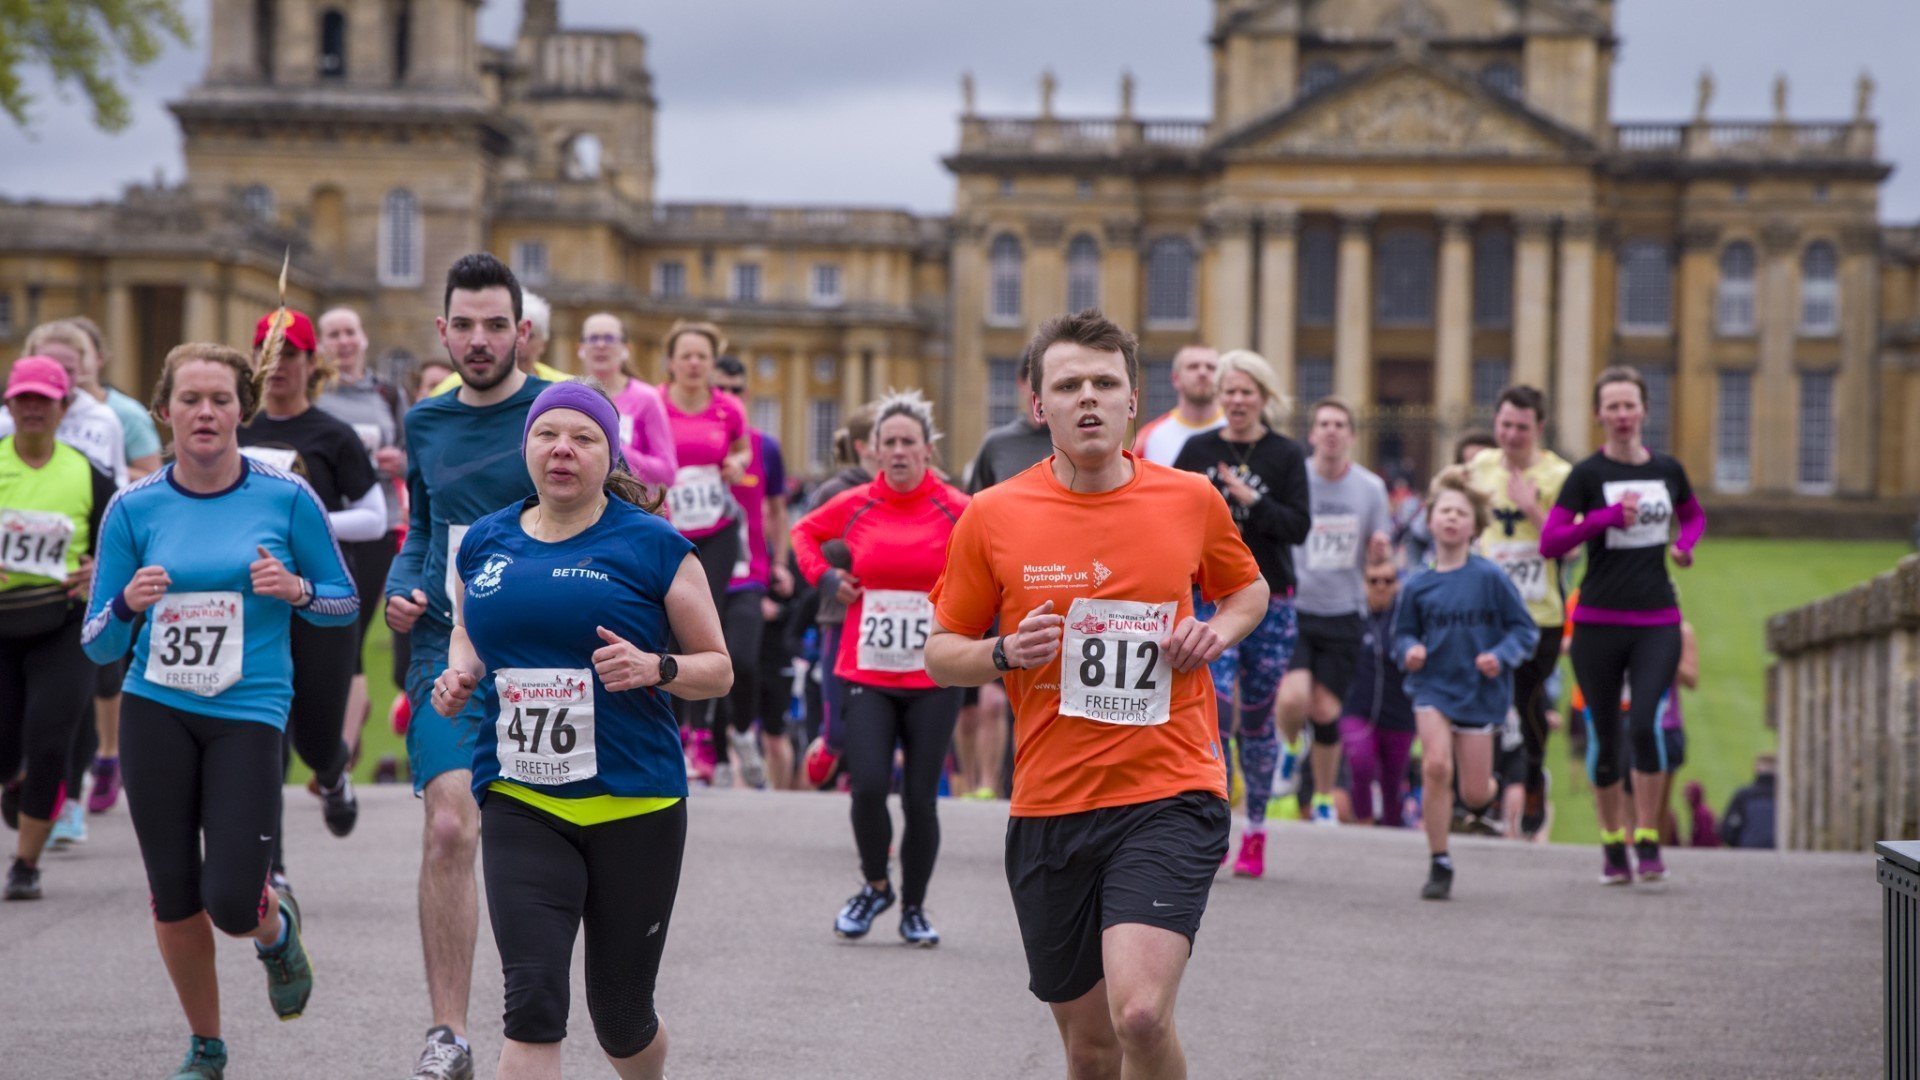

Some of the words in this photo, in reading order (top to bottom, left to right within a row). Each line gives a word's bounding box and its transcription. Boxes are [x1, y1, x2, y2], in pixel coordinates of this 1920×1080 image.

[672, 484, 722, 511] 1916
[2, 532, 65, 565] 1514
[552, 568, 609, 582] BETTINA
[1023, 563, 1066, 573] Muscular
[1023, 572, 1073, 583] Dystrophy
[1074, 571, 1088, 580] UK
[181, 609, 200, 619] FUN
[202, 608, 224, 617] RUN
[864, 616, 929, 650] 2315
[1108, 619, 1133, 631] FUN
[1134, 620, 1158, 632] RUN
[160, 626, 228, 667] 357
[1080, 637, 1159, 690] 812
[166, 672, 220, 685] FREETHS
[523, 687, 544, 699] FUN
[546, 687, 572, 698] RUN
[1085, 694, 1149, 711] FREETHS
[1085, 709, 1147, 722] SOLICITORS
[507, 707, 577, 755] 476
[516, 759, 570, 775] FREETHS
